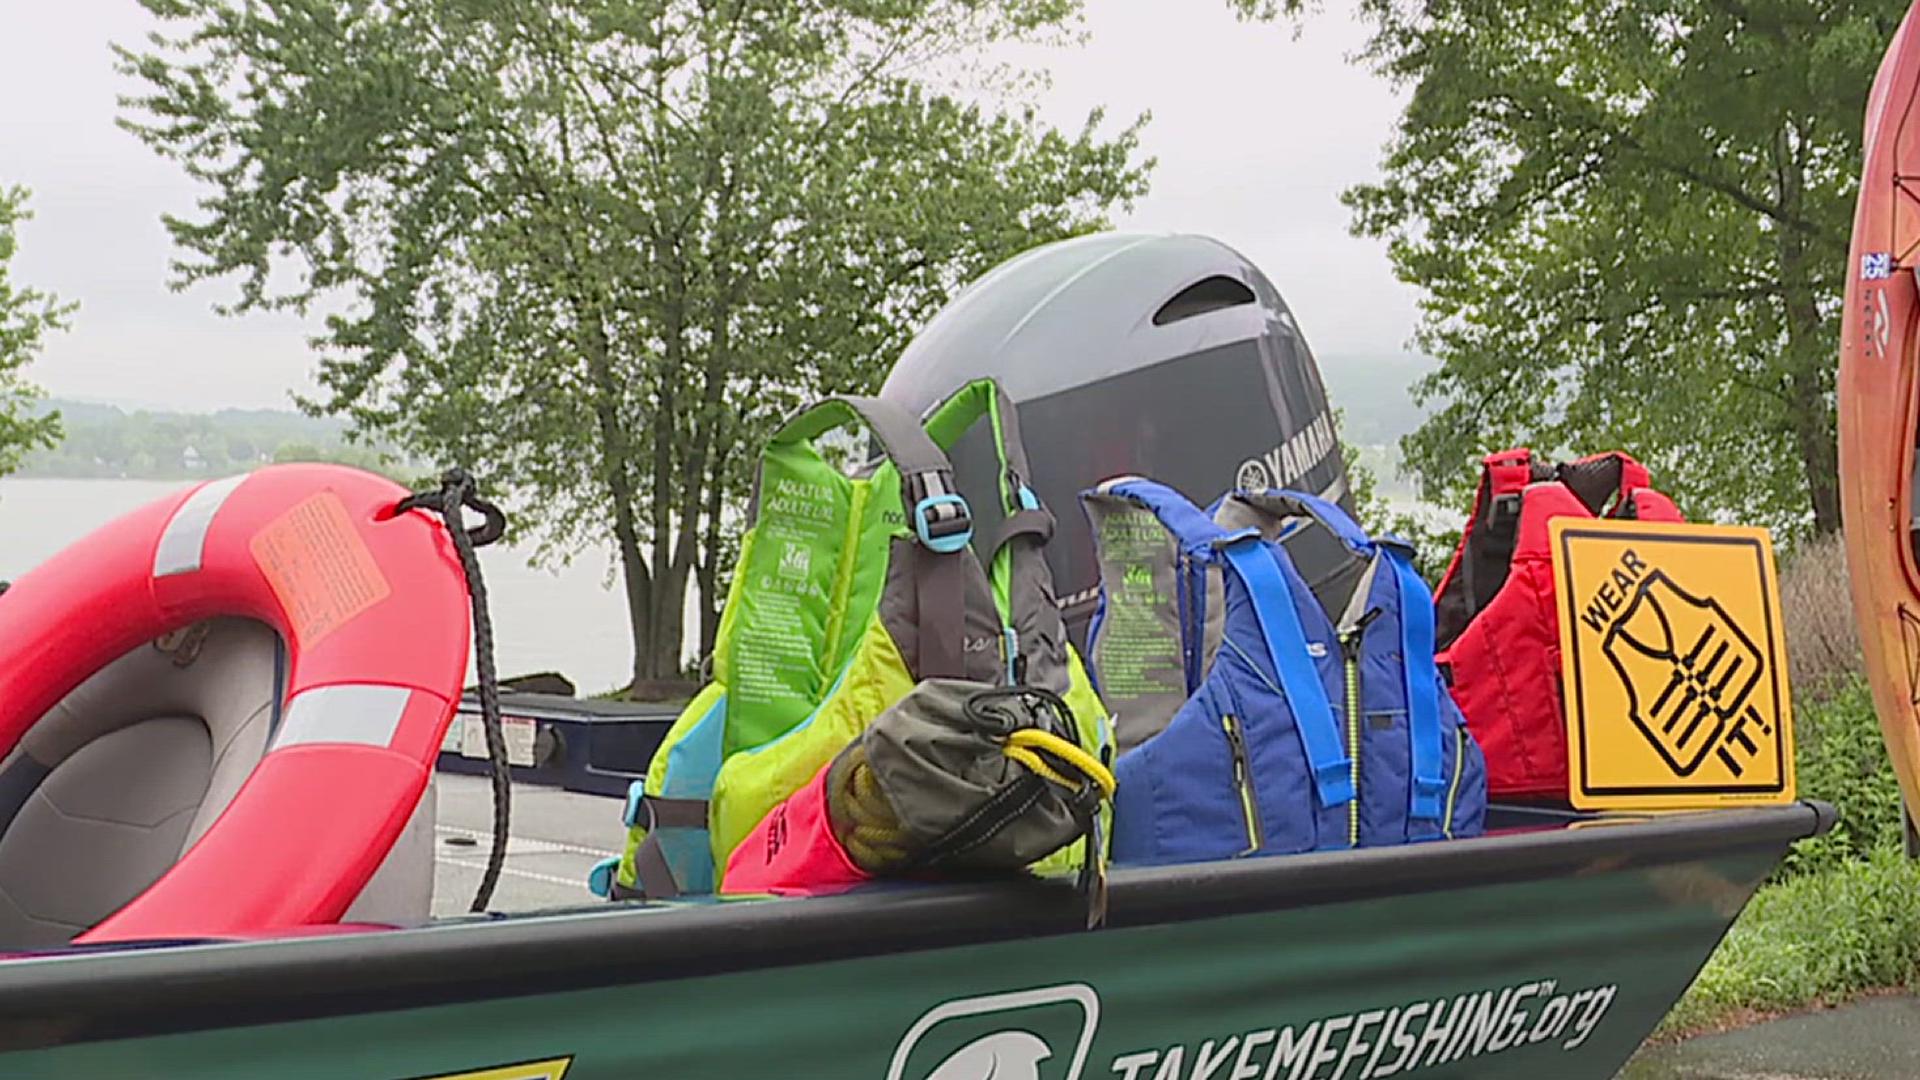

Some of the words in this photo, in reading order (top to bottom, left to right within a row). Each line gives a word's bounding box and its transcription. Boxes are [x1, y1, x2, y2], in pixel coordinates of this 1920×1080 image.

[1264, 410, 1334, 489] YAMAH
[1581, 549, 1647, 634] WEAR
[1716, 704, 1772, 777] IT!
